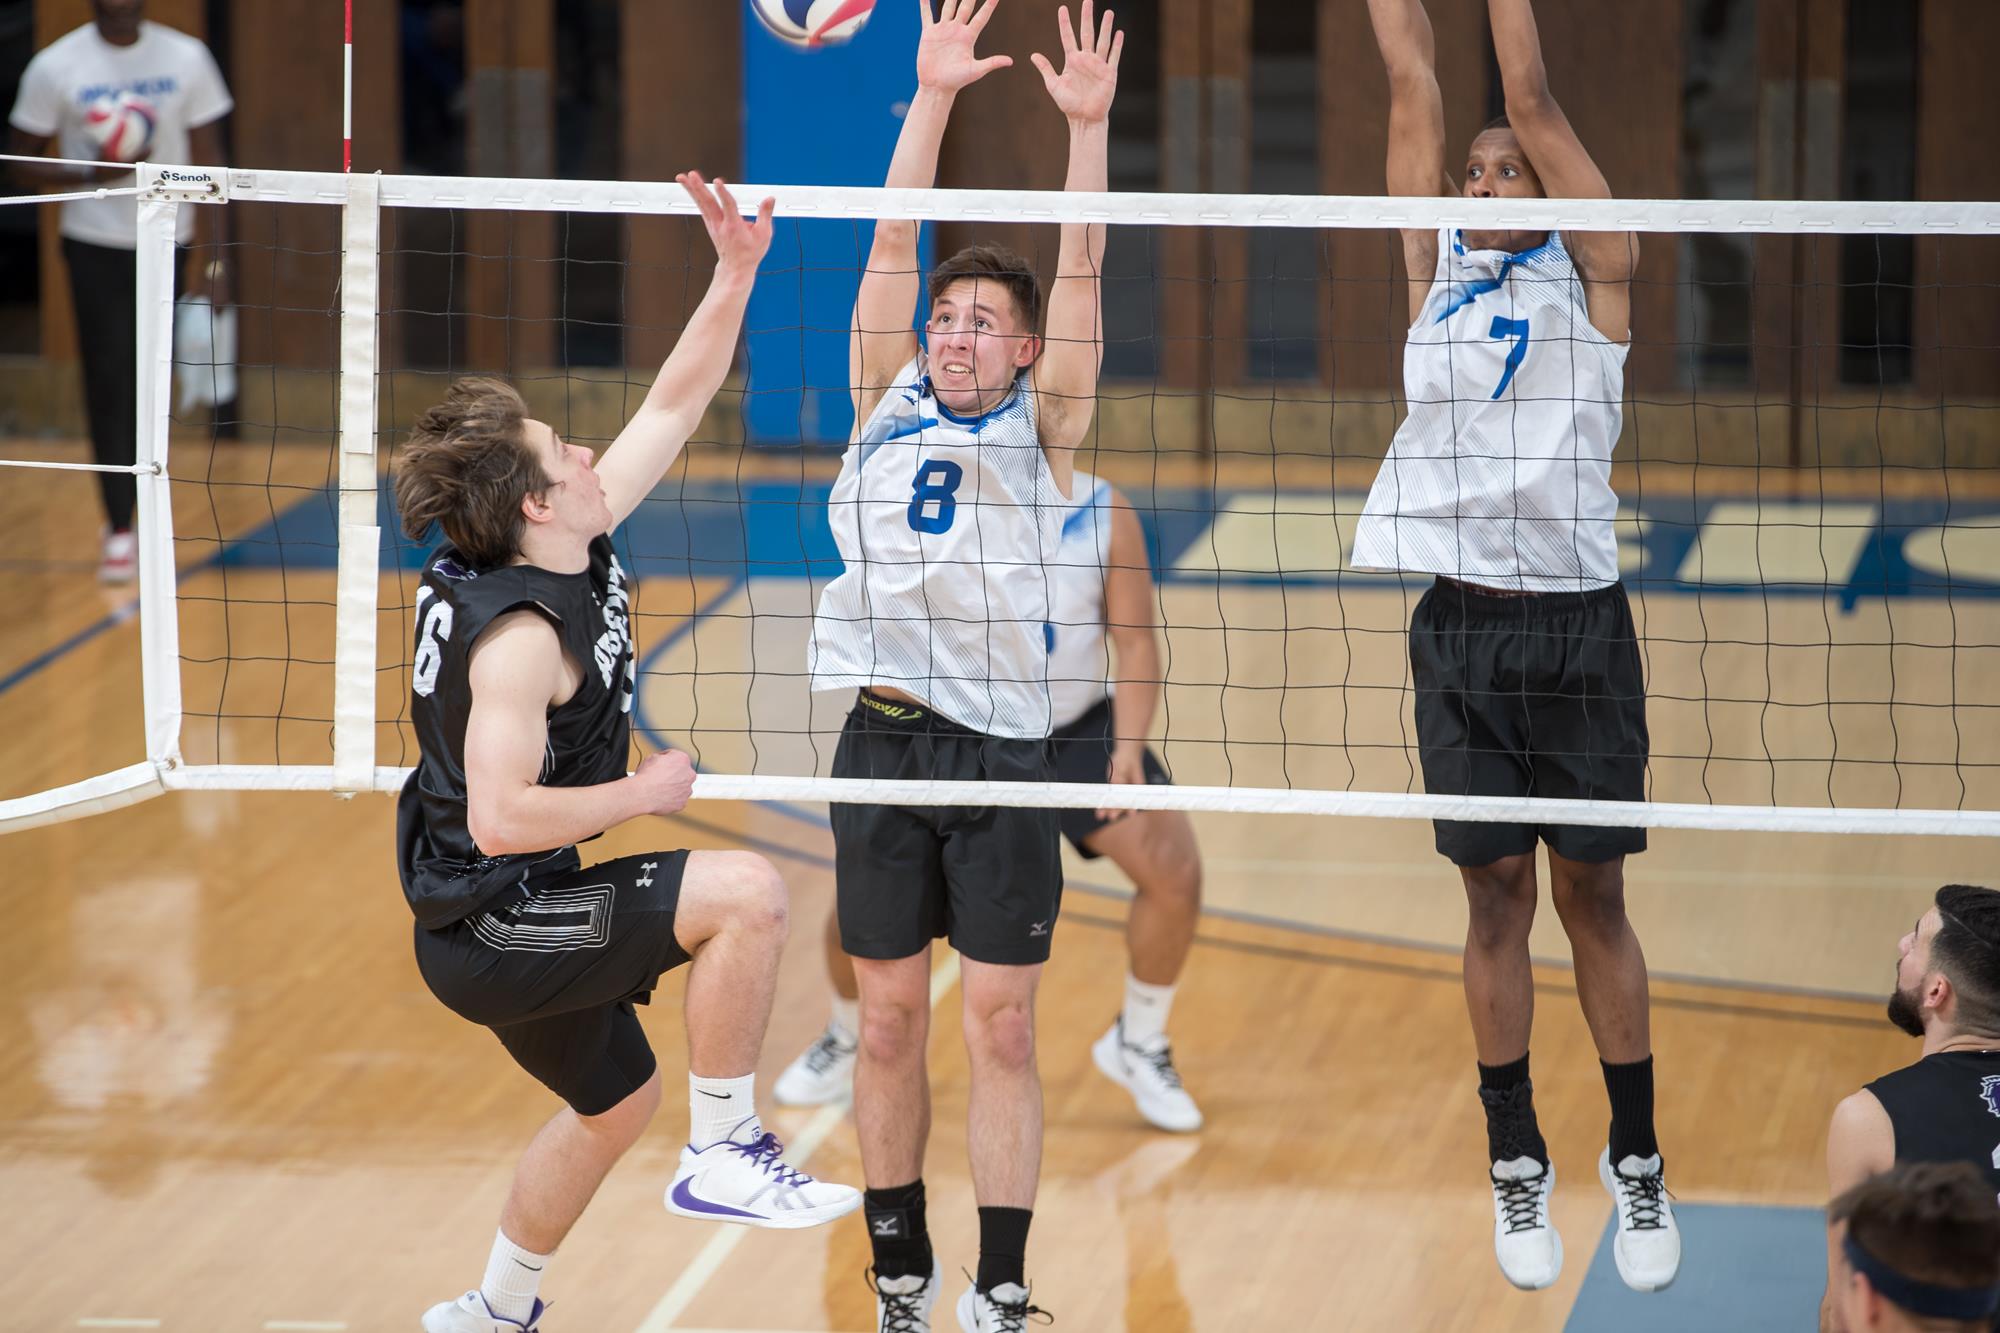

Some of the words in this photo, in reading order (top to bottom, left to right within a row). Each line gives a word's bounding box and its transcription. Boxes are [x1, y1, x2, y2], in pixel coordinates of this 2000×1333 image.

[172, 173, 211, 182] Senoh
[1489, 315, 1529, 399] 7
[907, 459, 963, 535] 8
